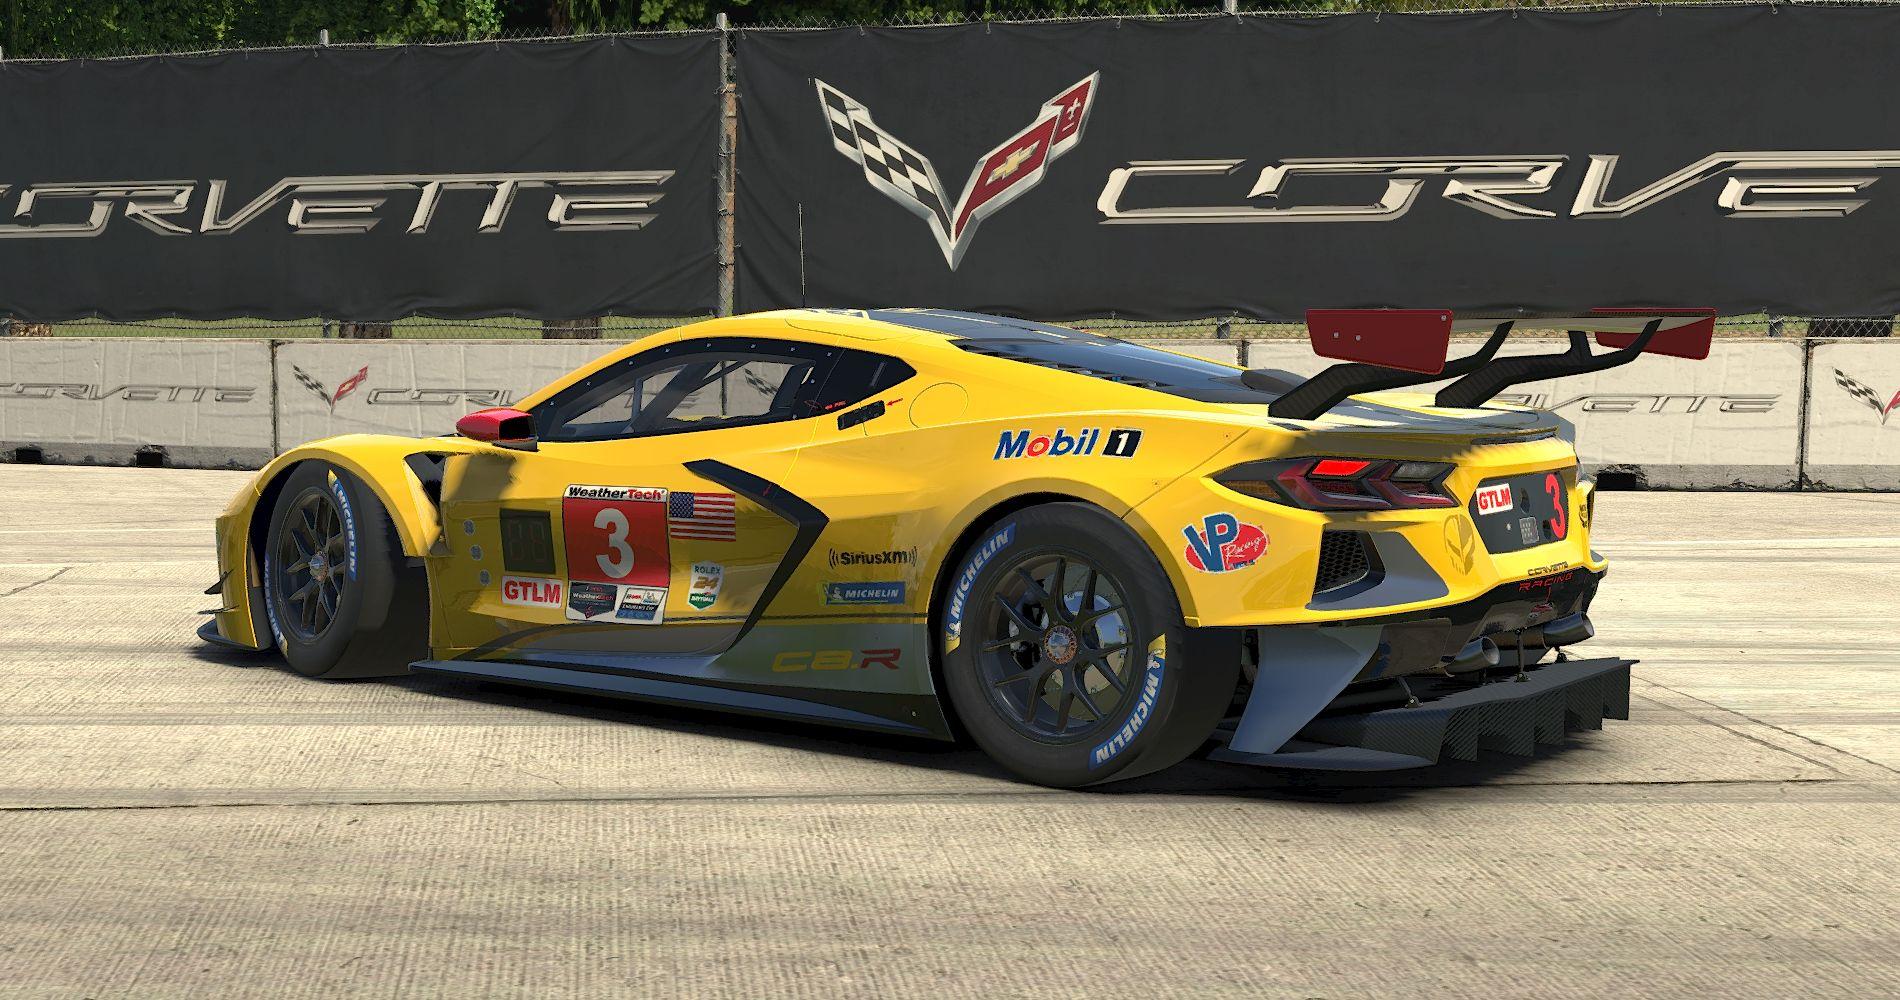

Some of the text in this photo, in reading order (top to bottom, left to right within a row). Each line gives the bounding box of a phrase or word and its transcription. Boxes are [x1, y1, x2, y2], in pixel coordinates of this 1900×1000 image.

[1097, 151, 1900, 224] CORVE
[0, 169, 675, 238] ORVETTE
[994, 429, 1100, 460] Mobil
[568, 486, 663, 501] WeatherTech
[1478, 486, 1512, 511] GTLM
[1545, 472, 1567, 539] 3
[337, 489, 357, 574] MICHELIN
[593, 507, 635, 579] 3
[1182, 512, 1240, 573] VP
[694, 565, 721, 576] ROLEX
[840, 550, 909, 566] SiriusXM
[1527, 561, 1569, 576] CORVETTE
[693, 576, 720, 589] 24
[950, 527, 1010, 620] MICHELIN
[1519, 572, 1574, 592] RACING
[504, 579, 561, 604] GTLM
[845, 588, 900, 599] MICHELIN
[771, 648, 902, 673] C8.R
[1095, 676, 1163, 765] MICHELIN
